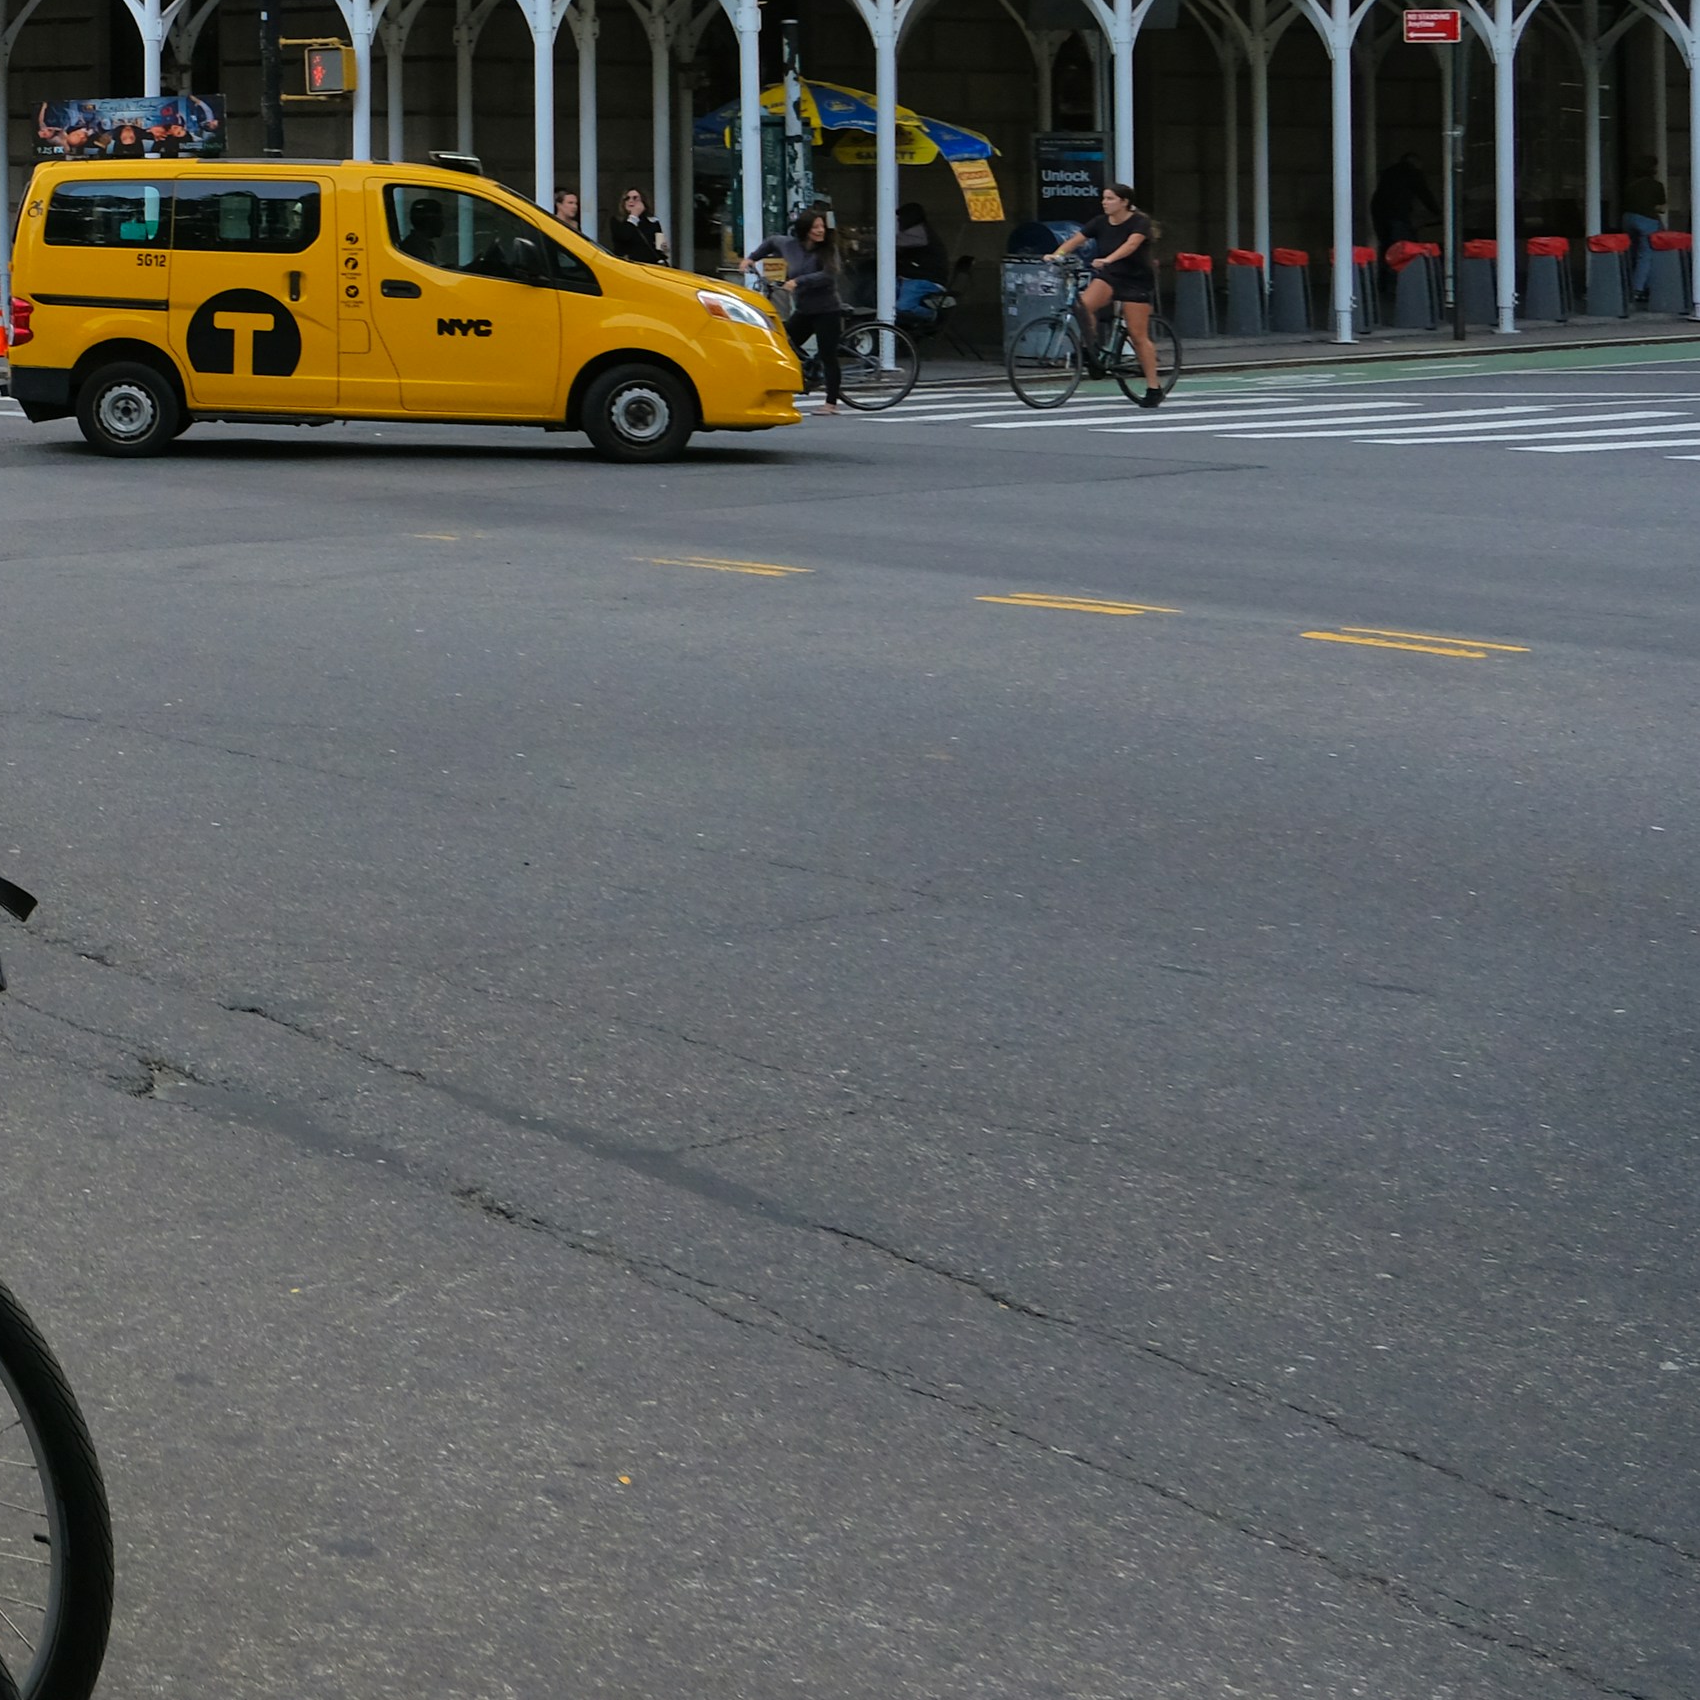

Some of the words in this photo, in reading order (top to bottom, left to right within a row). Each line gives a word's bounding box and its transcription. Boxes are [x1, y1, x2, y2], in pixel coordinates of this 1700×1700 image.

[1041, 170, 1090, 182] Unlock
[1042, 184, 1099, 198] gridlock
[437, 317, 493, 338] NYC
